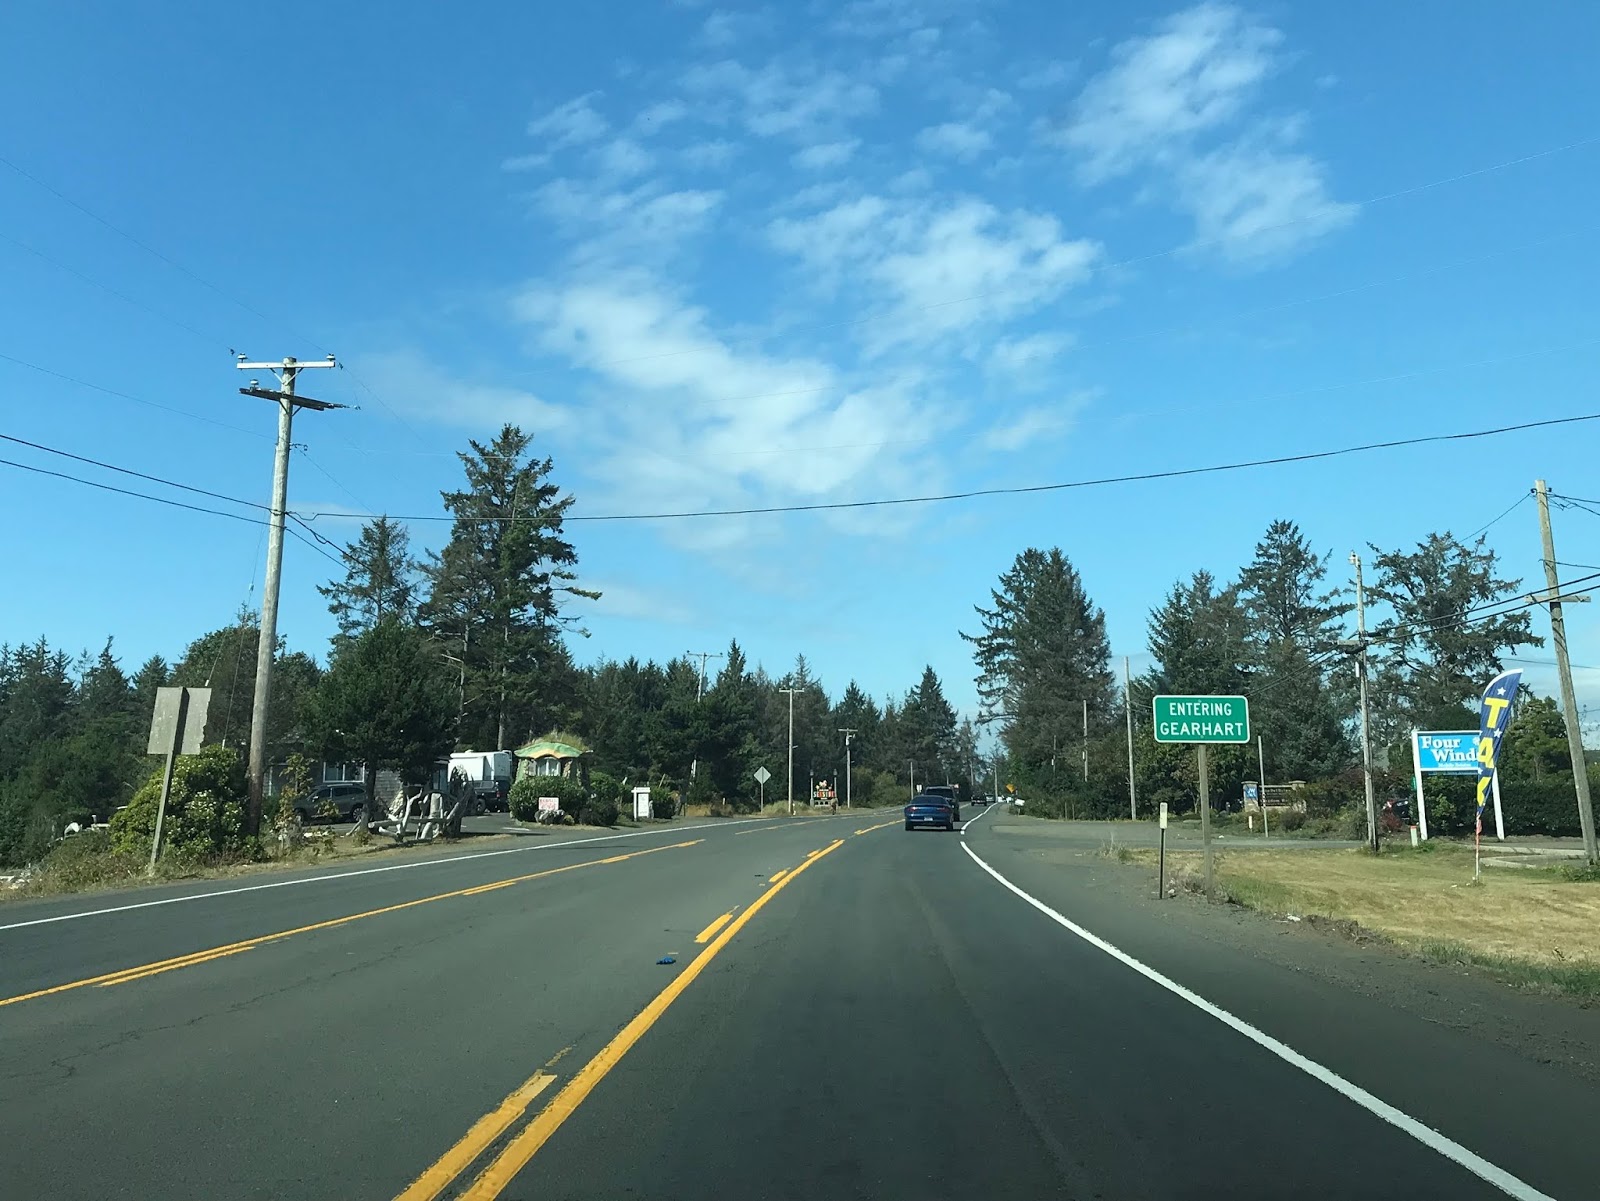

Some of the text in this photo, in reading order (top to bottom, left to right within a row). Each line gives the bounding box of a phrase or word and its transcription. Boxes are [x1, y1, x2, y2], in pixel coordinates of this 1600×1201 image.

[1169, 702, 1232, 716] ENTERING
[1160, 722, 1244, 736] GEARHART
[1420, 735, 1462, 749] Four
[1430, 748, 1479, 762] Wind
